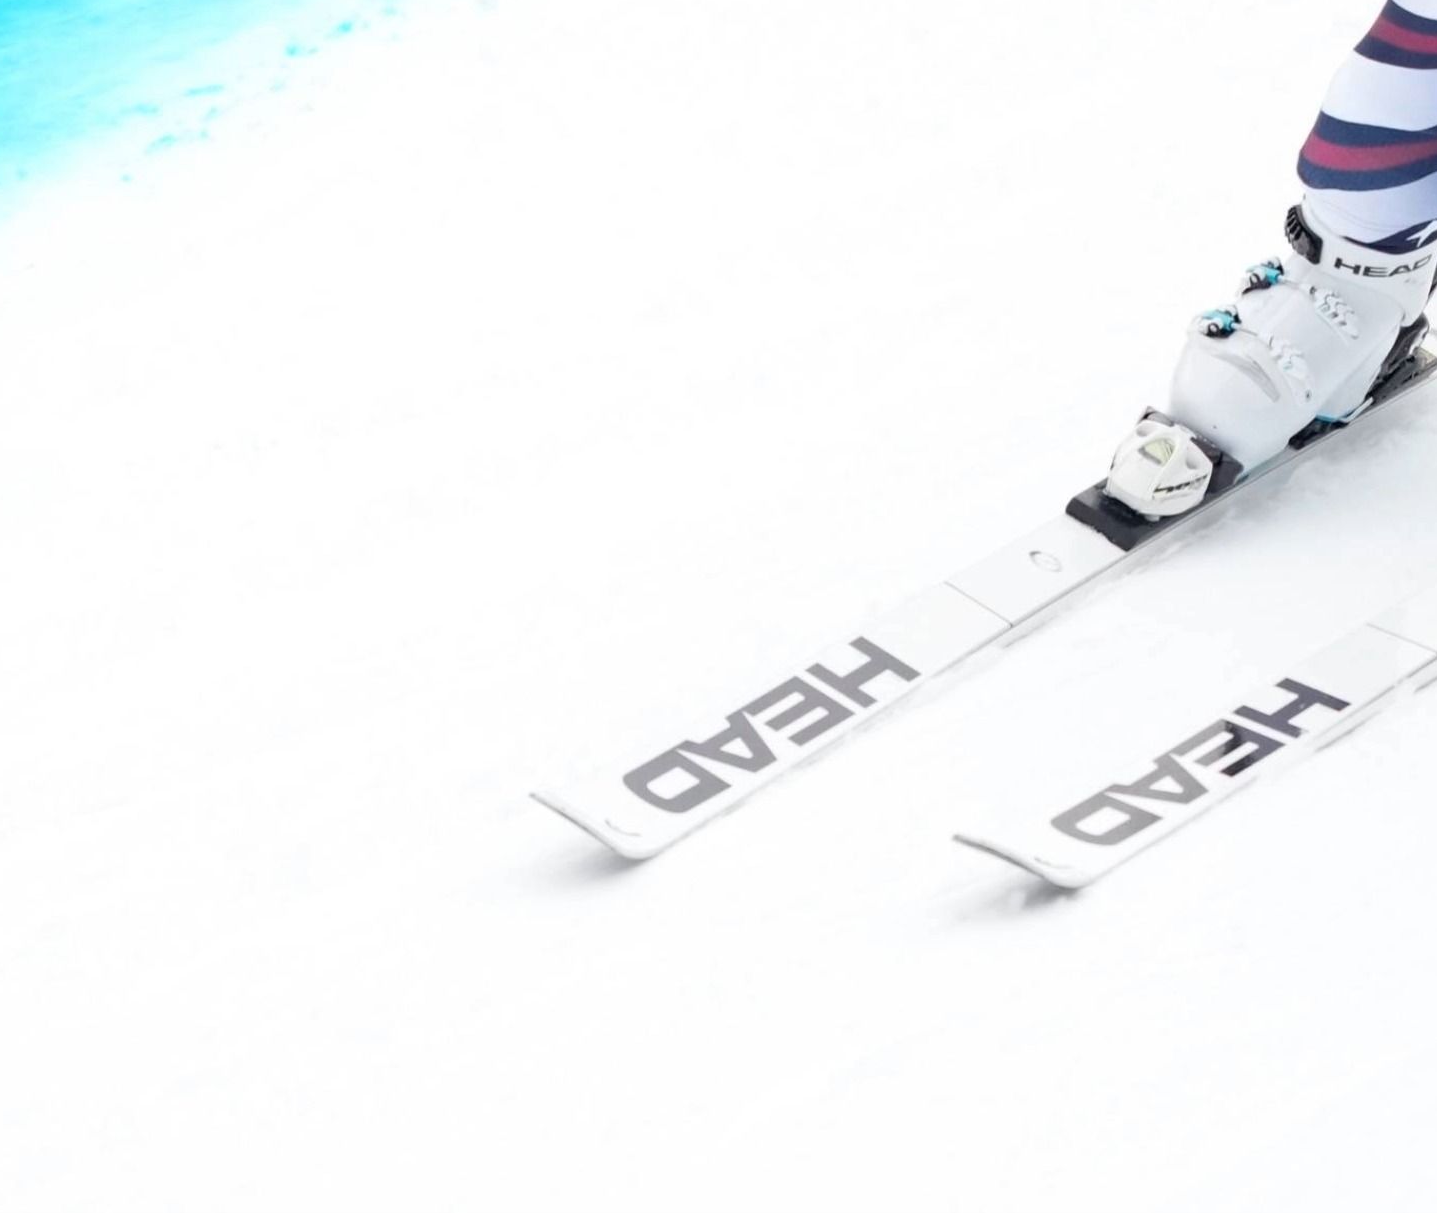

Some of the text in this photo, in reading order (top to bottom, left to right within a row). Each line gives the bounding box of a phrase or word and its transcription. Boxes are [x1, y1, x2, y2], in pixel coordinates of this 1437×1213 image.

[1334, 253, 1433, 278] HEAD
[622, 635, 921, 814] HEAD
[1050, 676, 1351, 847] HEAD
